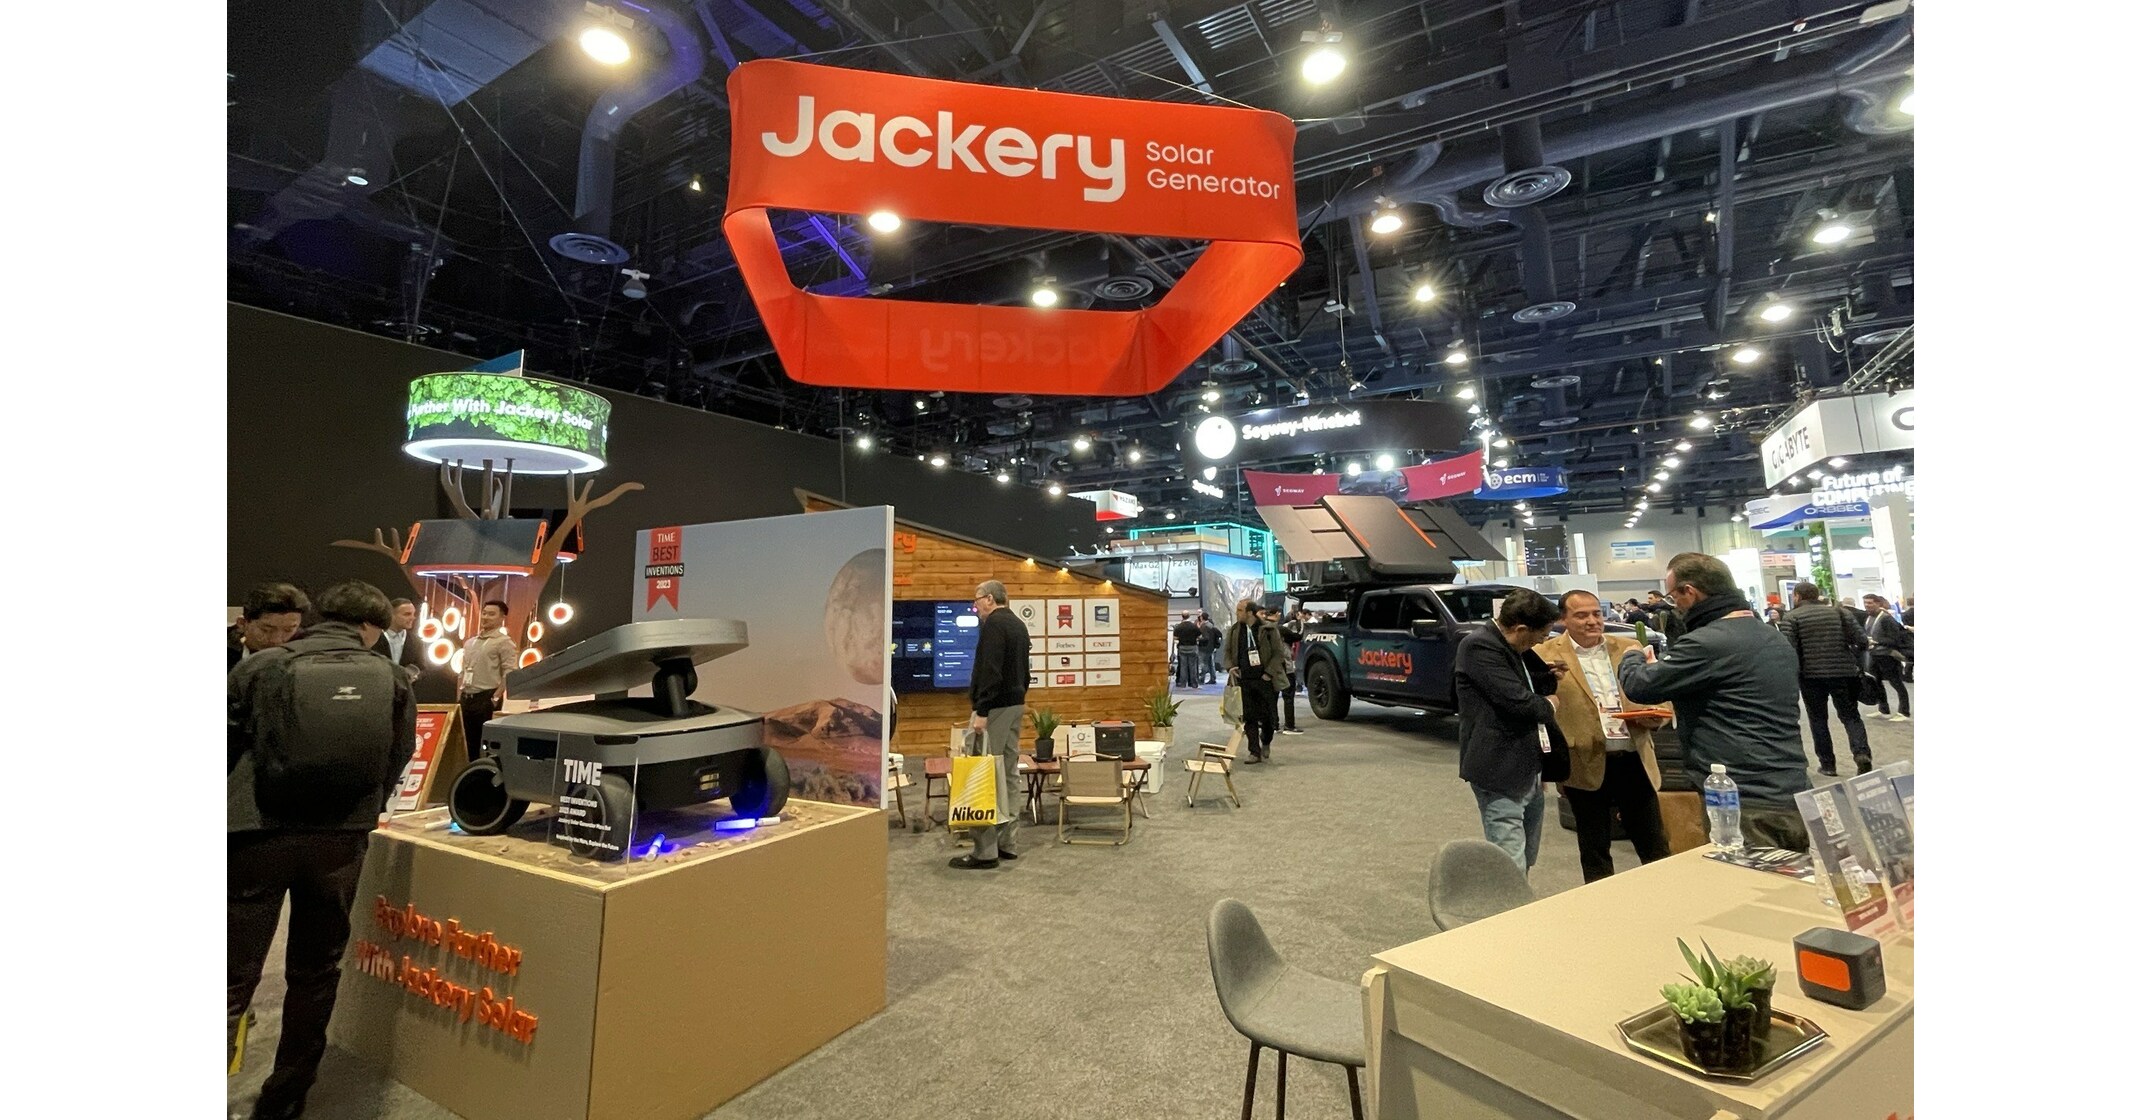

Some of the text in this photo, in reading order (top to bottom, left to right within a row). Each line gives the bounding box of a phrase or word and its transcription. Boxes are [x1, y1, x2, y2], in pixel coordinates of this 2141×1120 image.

[762, 96, 1125, 202] Jackery
[1146, 141, 1214, 165] Solar
[1147, 170, 1280, 200] Generator
[452, 398, 490, 414] With
[494, 400, 560, 424] Jackery
[562, 411, 594, 430] Solar
[1771, 426, 1810, 469] GIGABYTE
[1504, 473, 1537, 485] ecm
[1822, 464, 1905, 491] Future of
[657, 532, 676, 543] TIME
[652, 545, 679, 562] BEST
[646, 565, 684, 576] INVENTIONS
[656, 579, 671, 589] 2023
[1305, 633, 1340, 646] APTOR
[1358, 648, 1413, 674] Jackery
[563, 759, 603, 786] TIME
[951, 806, 996, 822] Nikon
[373, 894, 522, 977] Explore Further
[355, 938, 538, 1044] With Jackery Solar
